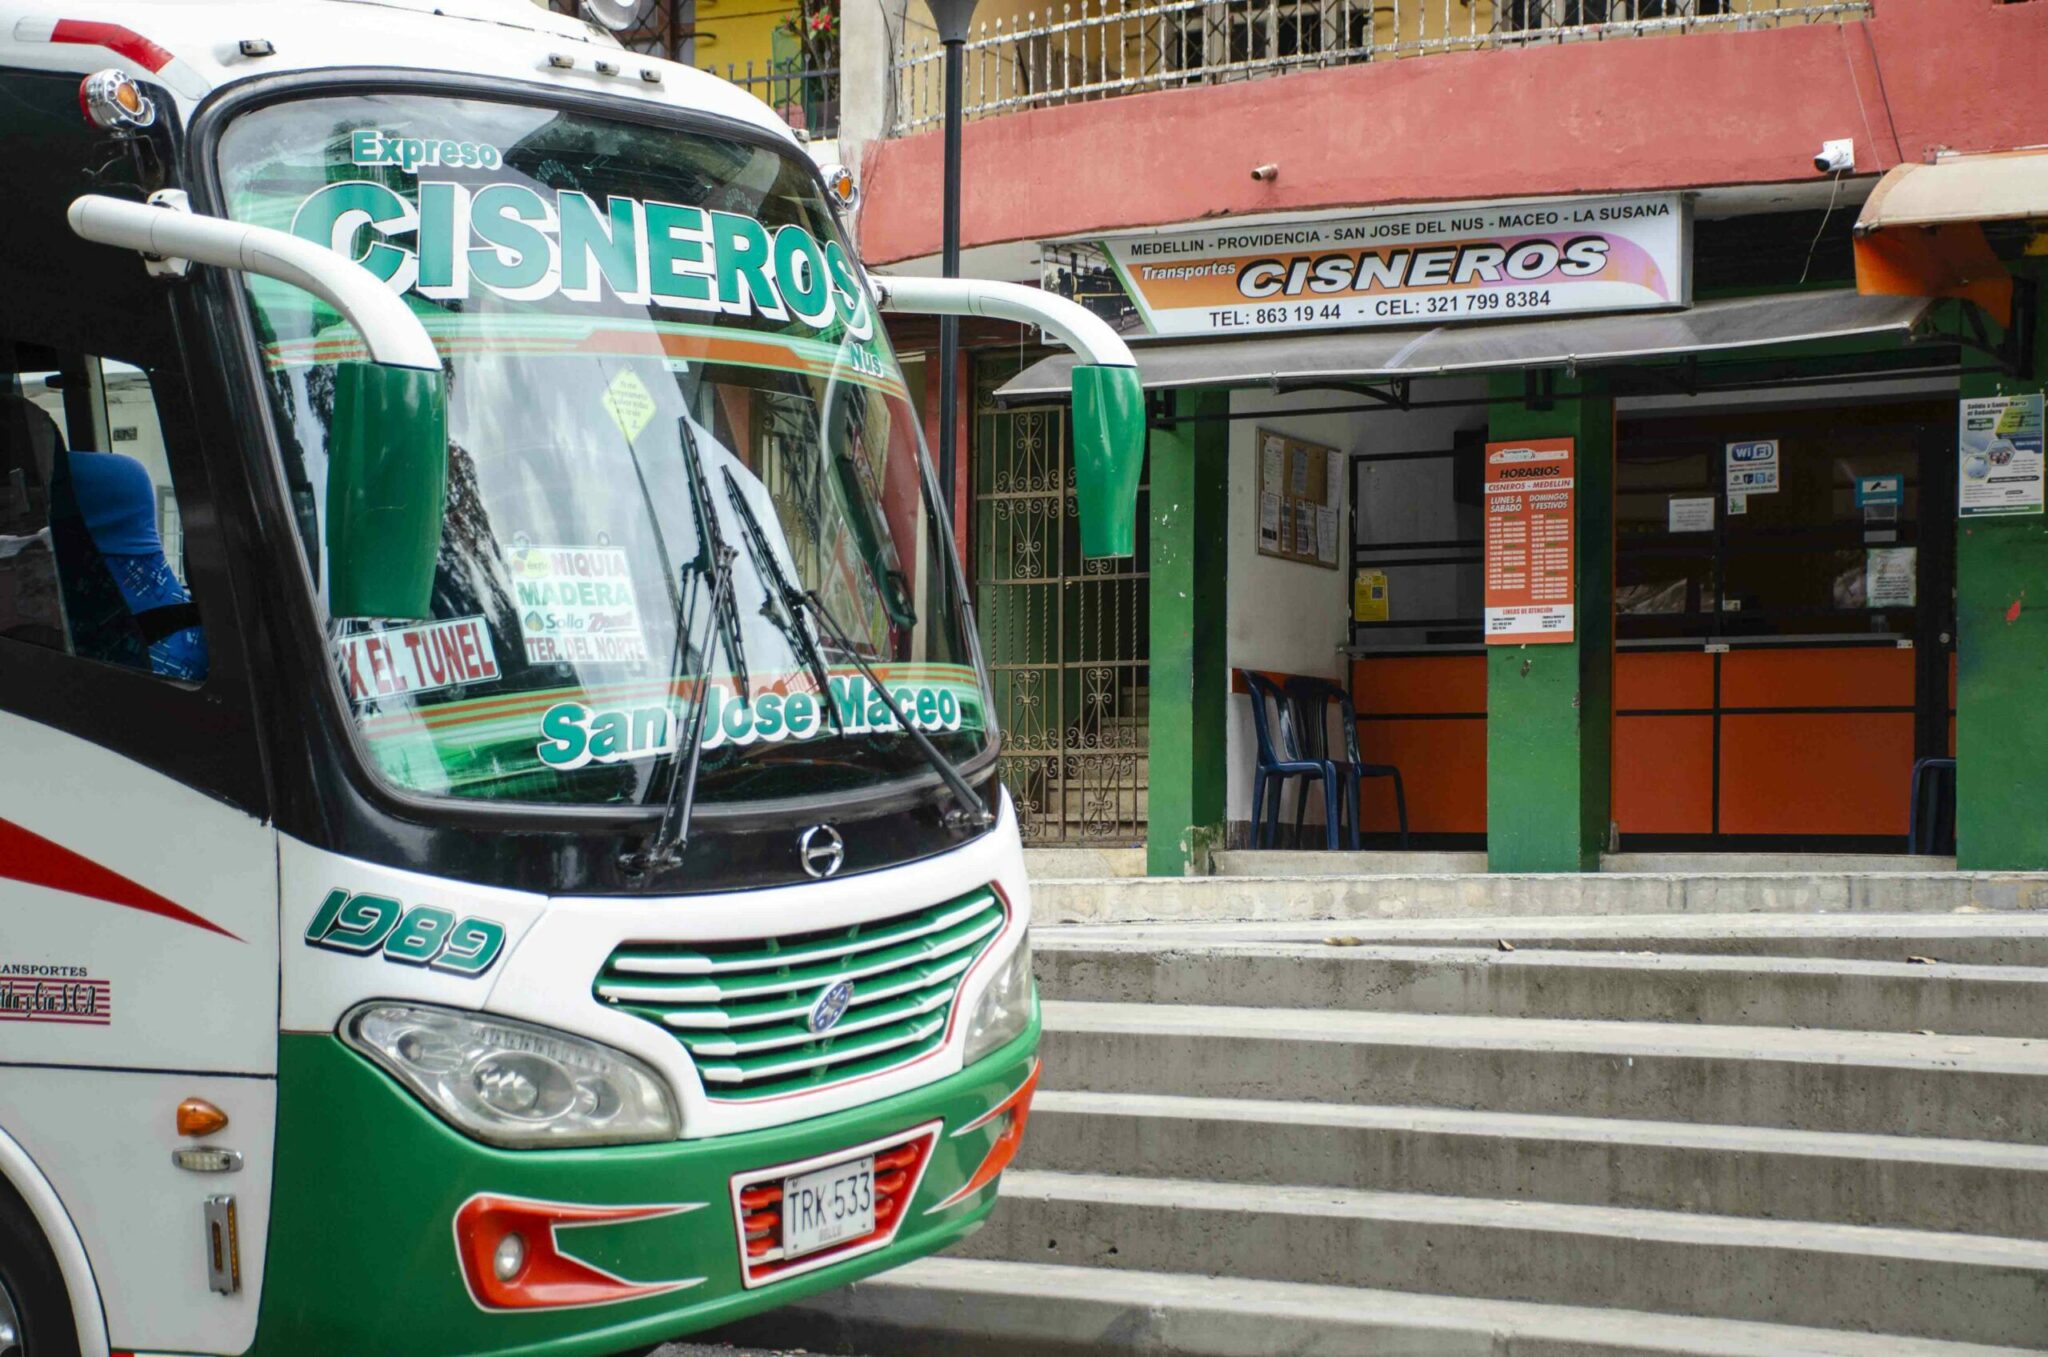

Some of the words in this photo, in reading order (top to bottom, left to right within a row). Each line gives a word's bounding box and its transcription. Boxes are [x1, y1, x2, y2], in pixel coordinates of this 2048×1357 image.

[352, 130, 502, 174] Expreso
[1131, 239, 1204, 256] MEDELLIN
[1217, 231, 1320, 250] PROVIDENCIA
[1333, 227, 1365, 241] SAN
[1370, 223, 1411, 238] JOSE
[1415, 220, 1446, 235] DEL
[1451, 217, 1484, 232] NUS
[1498, 212, 1558, 228] MACEO
[1573, 209, 1595, 223] LA
[1599, 203, 1669, 221] SUSANA
[291, 180, 874, 341] CISNEROS
[1141, 260, 1236, 281] Transportes
[1236, 235, 1610, 298] CISNEROS
[1210, 310, 1250, 327] TEL:
[1256, 307, 1288, 324] 863
[1294, 305, 1313, 321] 19
[1320, 304, 1341, 319] 44
[1375, 299, 1420, 316] CEL:
[1427, 296, 1458, 313] 321
[1466, 293, 1499, 310] 799
[1505, 290, 1551, 307] 8384
[847, 340, 884, 378] Nus
[1499, 465, 1560, 479] HORARIOS
[1488, 483, 1526, 491] CISNEROS
[1532, 480, 1571, 489] MEDELLIN
[1529, 493, 1569, 502] DOMINGOS
[1490, 496, 1515, 505] LUNES
[1536, 501, 1568, 510] FESTIVOS
[516, 581, 633, 606] MADERA
[545, 612, 584, 629] Solla
[365, 635, 408, 694] EL
[402, 622, 496, 687] TUNEL
[564, 637, 594, 660] DEL
[538, 701, 676, 770] San
[692, 684, 822, 749] Jose
[828, 675, 961, 735] Maceo
[304, 886, 506, 980] 1989
[0, 964, 88, 977] ANSPORTES
